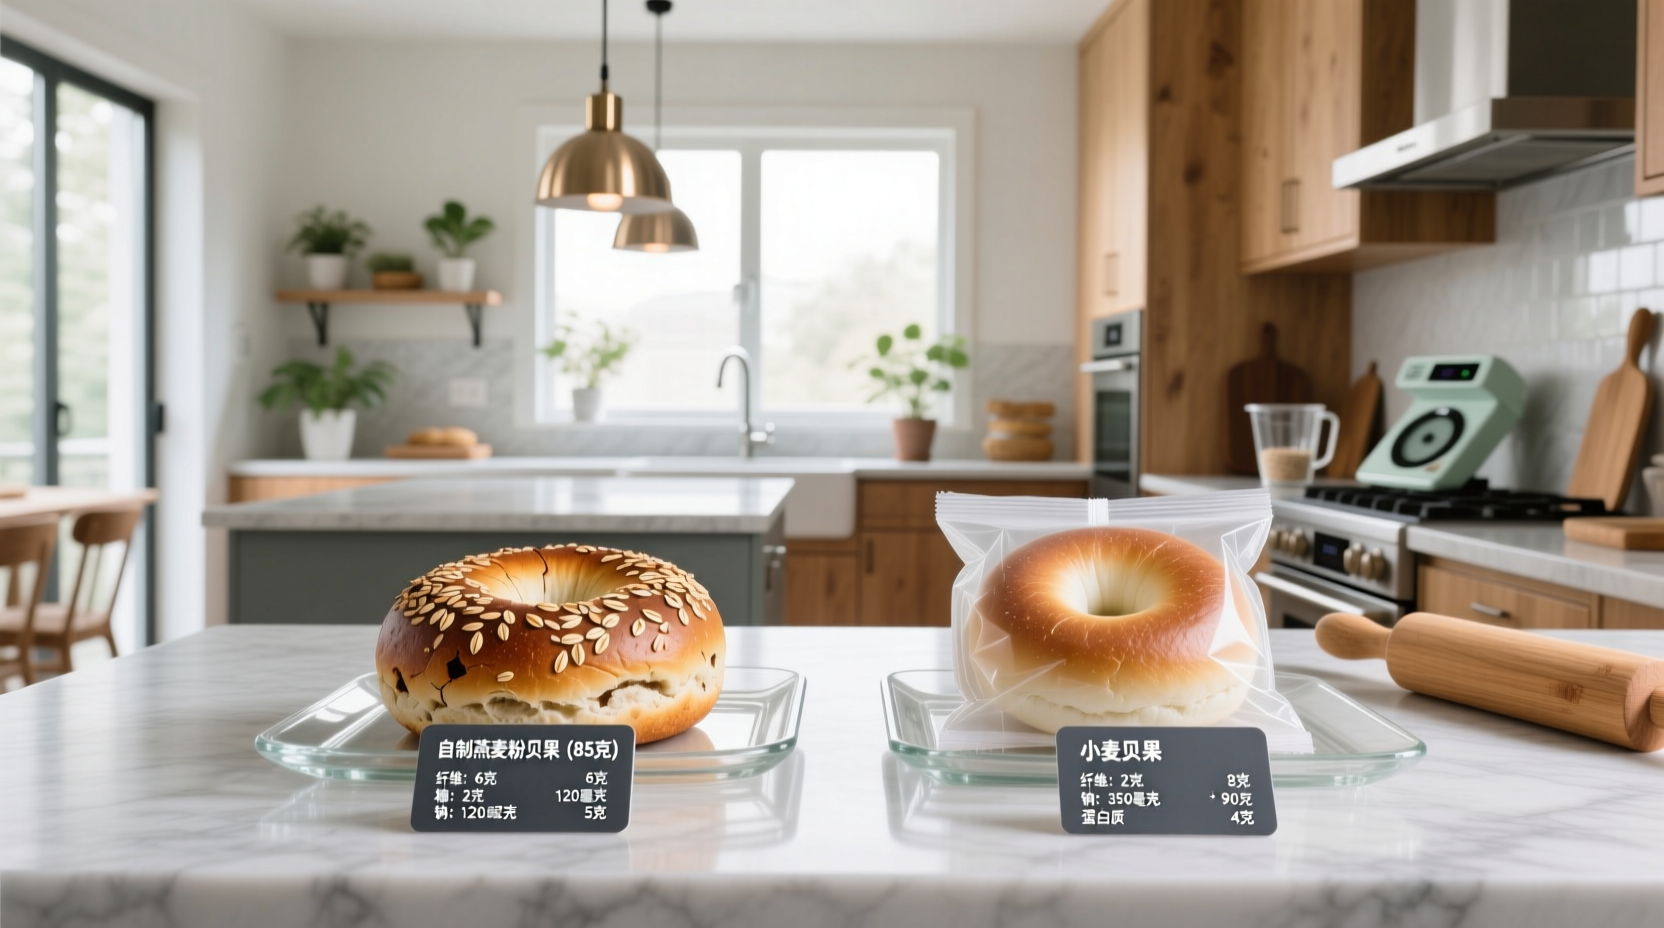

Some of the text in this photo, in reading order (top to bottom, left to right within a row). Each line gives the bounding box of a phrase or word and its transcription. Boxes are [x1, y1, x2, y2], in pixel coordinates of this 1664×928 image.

[567, 738, 619, 761] (85克)
[1080, 739, 1162, 762] 小麦贝果
[585, 769, 608, 785] 6克
[584, 804, 607, 820] 5克
[1230, 809, 1255, 825] 4克
